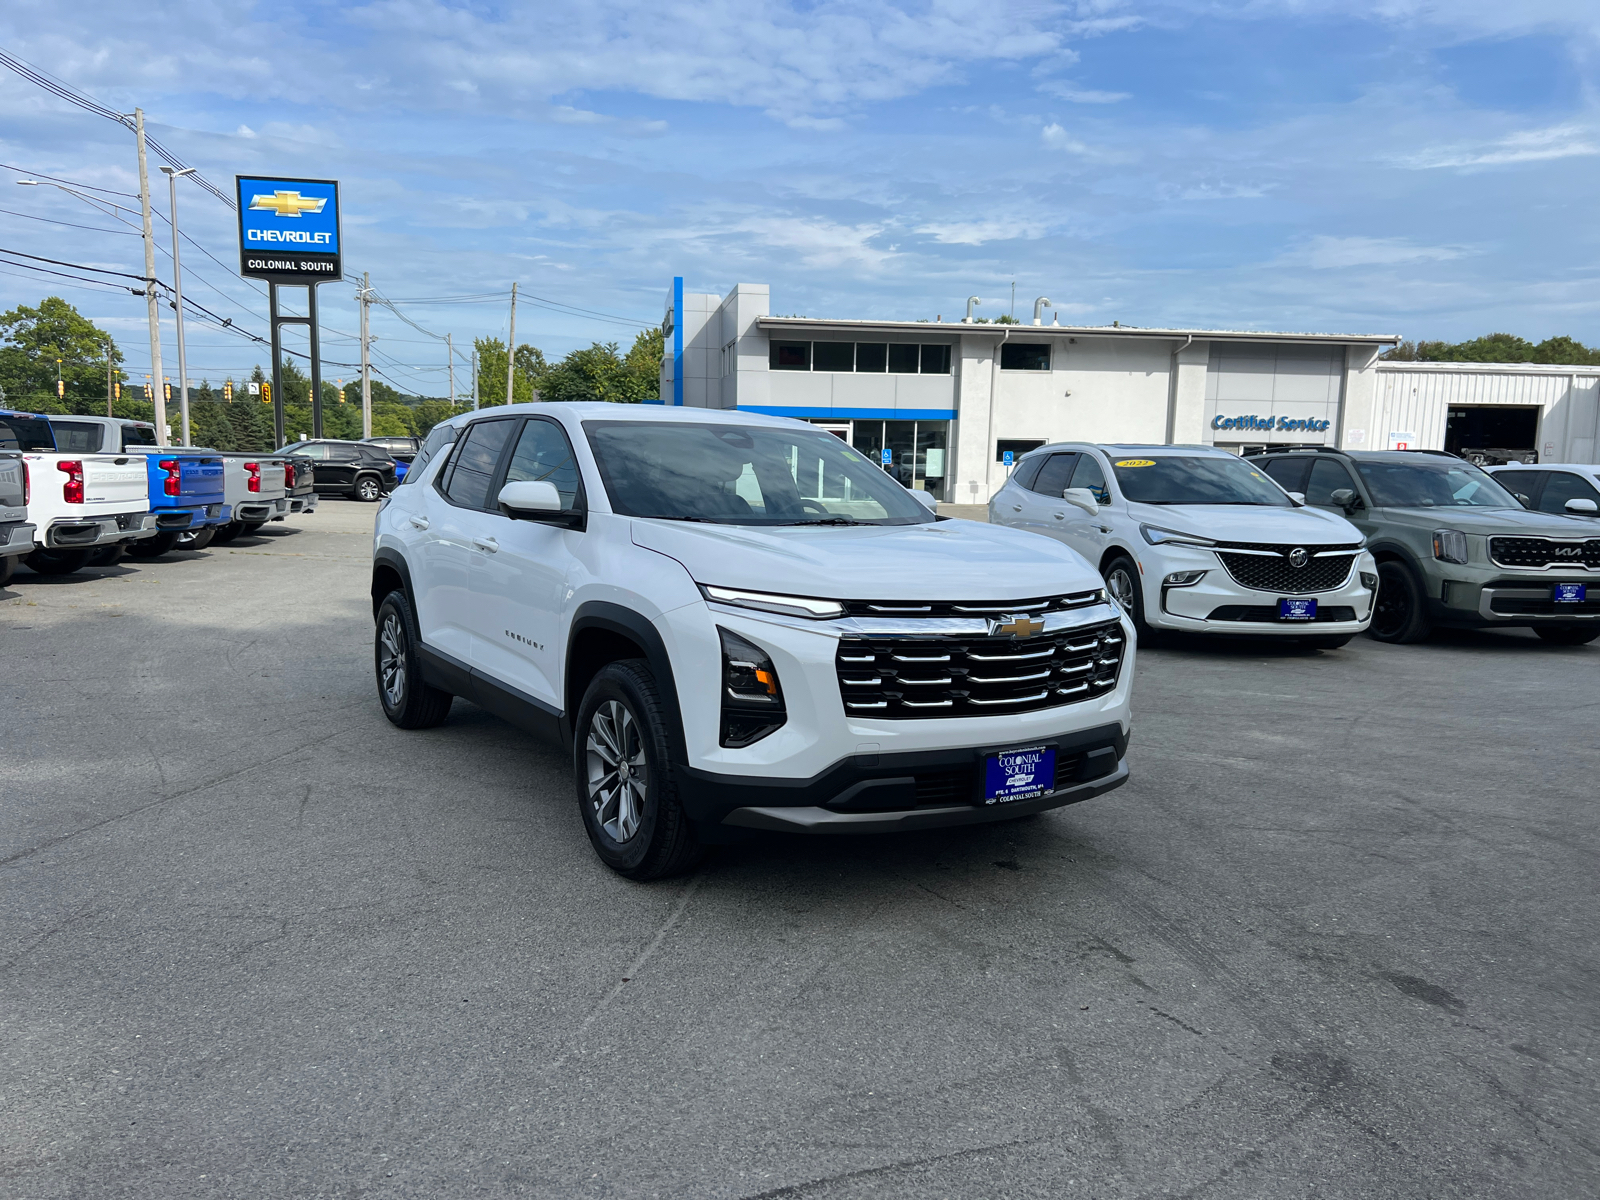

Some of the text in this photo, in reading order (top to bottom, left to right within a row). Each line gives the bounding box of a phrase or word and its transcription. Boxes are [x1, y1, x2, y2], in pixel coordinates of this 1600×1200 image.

[247, 229, 332, 244] CHEVROLET
[248, 259, 334, 271] COLONIAL SOUTH
[1213, 414, 1330, 431] Certified Service
[999, 753, 1042, 767] COLONIAL
[1005, 763, 1035, 775] SOUTH
[1000, 791, 1041, 803] COLONIAL SOUTH
